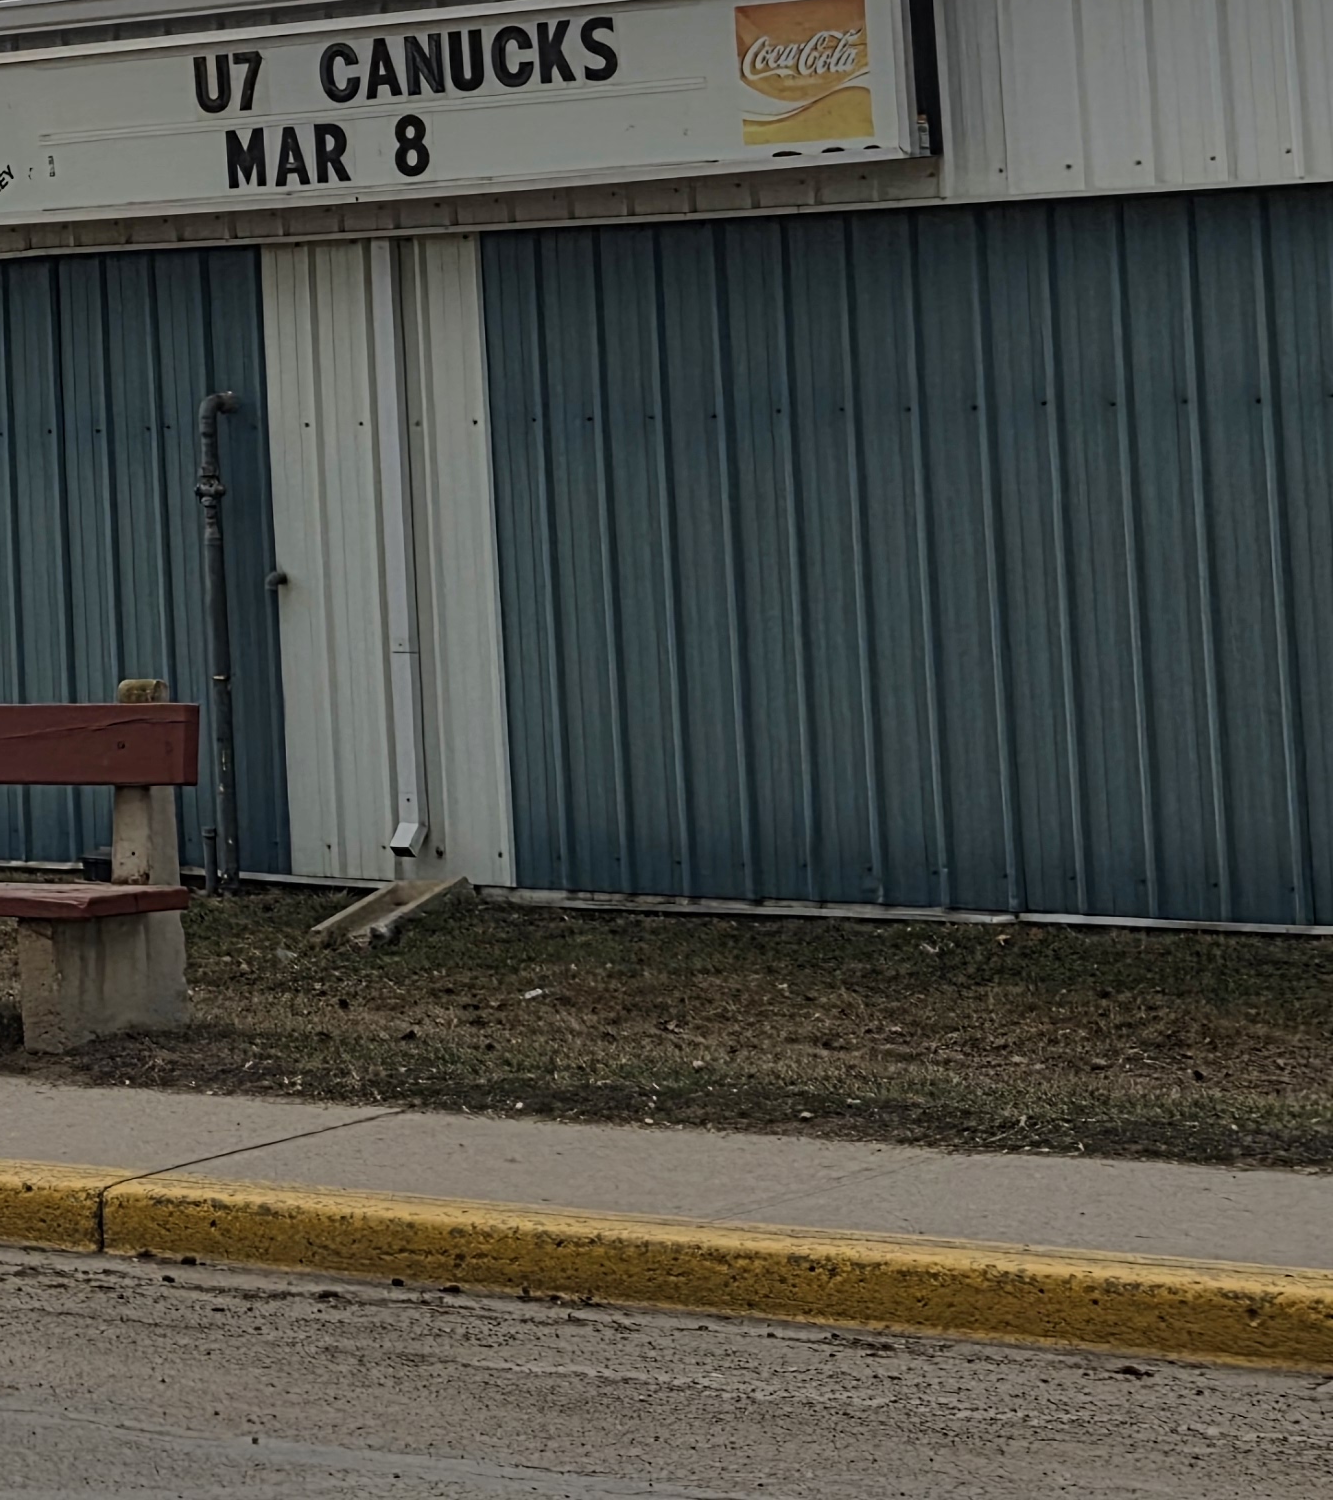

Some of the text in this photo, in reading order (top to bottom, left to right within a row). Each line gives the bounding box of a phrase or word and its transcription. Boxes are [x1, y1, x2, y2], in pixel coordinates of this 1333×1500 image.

[193, 16, 619, 113] U7 CANUCKS
[225, 114, 430, 189] MAR 8
